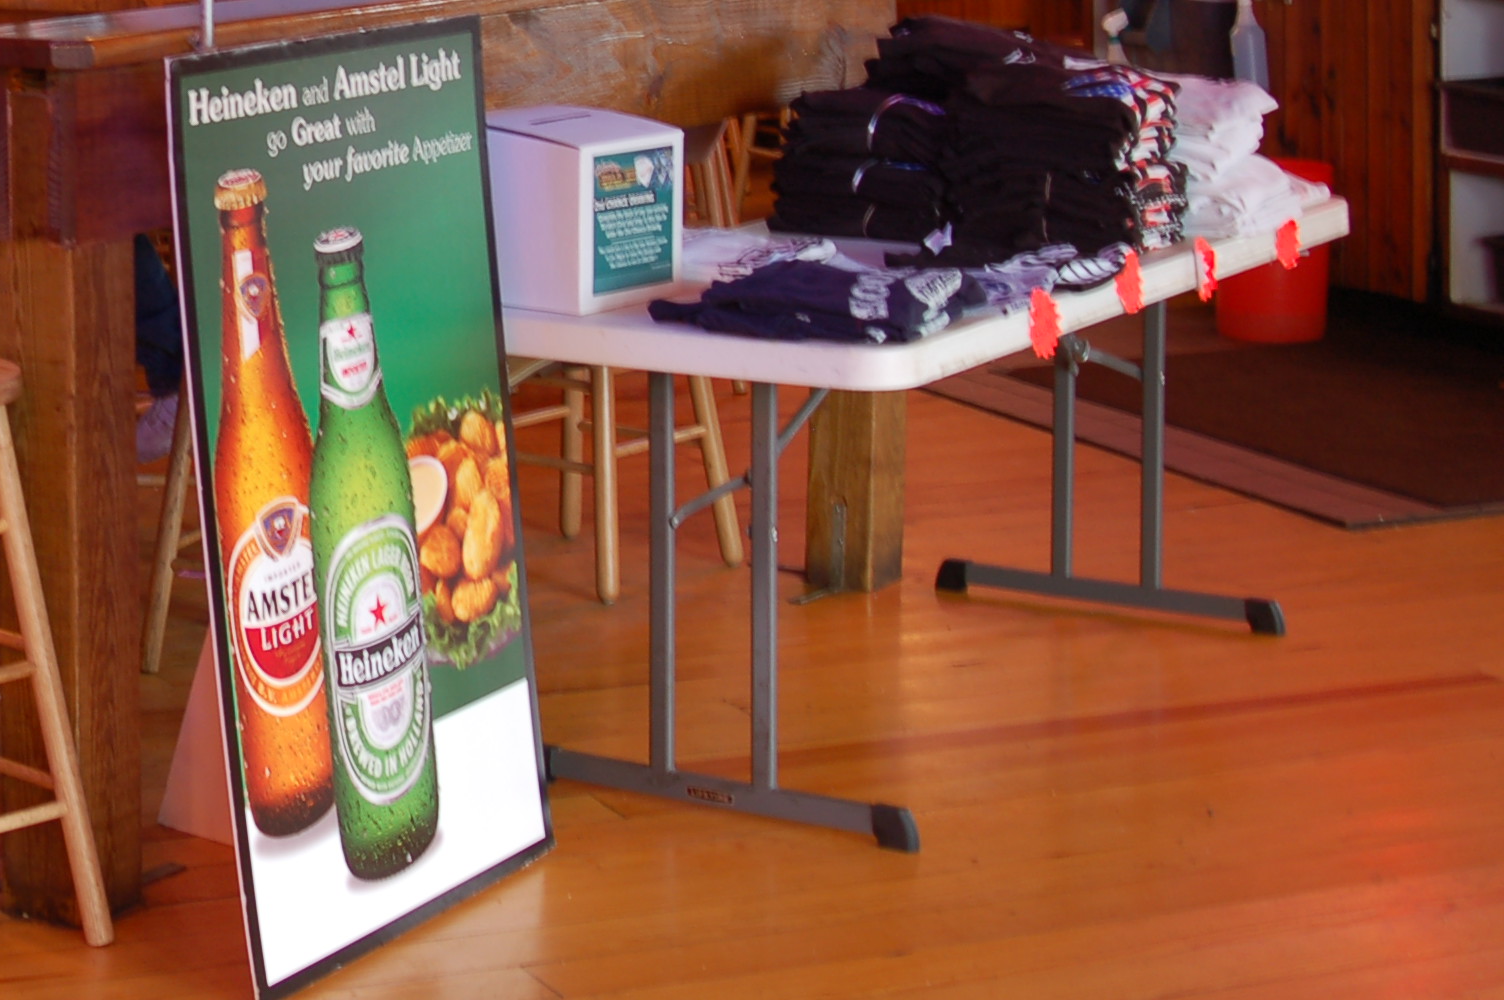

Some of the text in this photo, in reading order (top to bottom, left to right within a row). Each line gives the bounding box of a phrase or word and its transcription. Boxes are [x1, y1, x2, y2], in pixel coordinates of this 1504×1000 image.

[188, 48, 462, 126] Heineken and Amstel Light
[266, 106, 376, 157] go Great with
[302, 157, 343, 190] your
[344, 139, 410, 182] favorite
[412, 131, 474, 164] Appetizer
[260, 607, 315, 651] LIGHT
[338, 619, 420, 687] Heineken
[384, 753, 399, 776] IN
